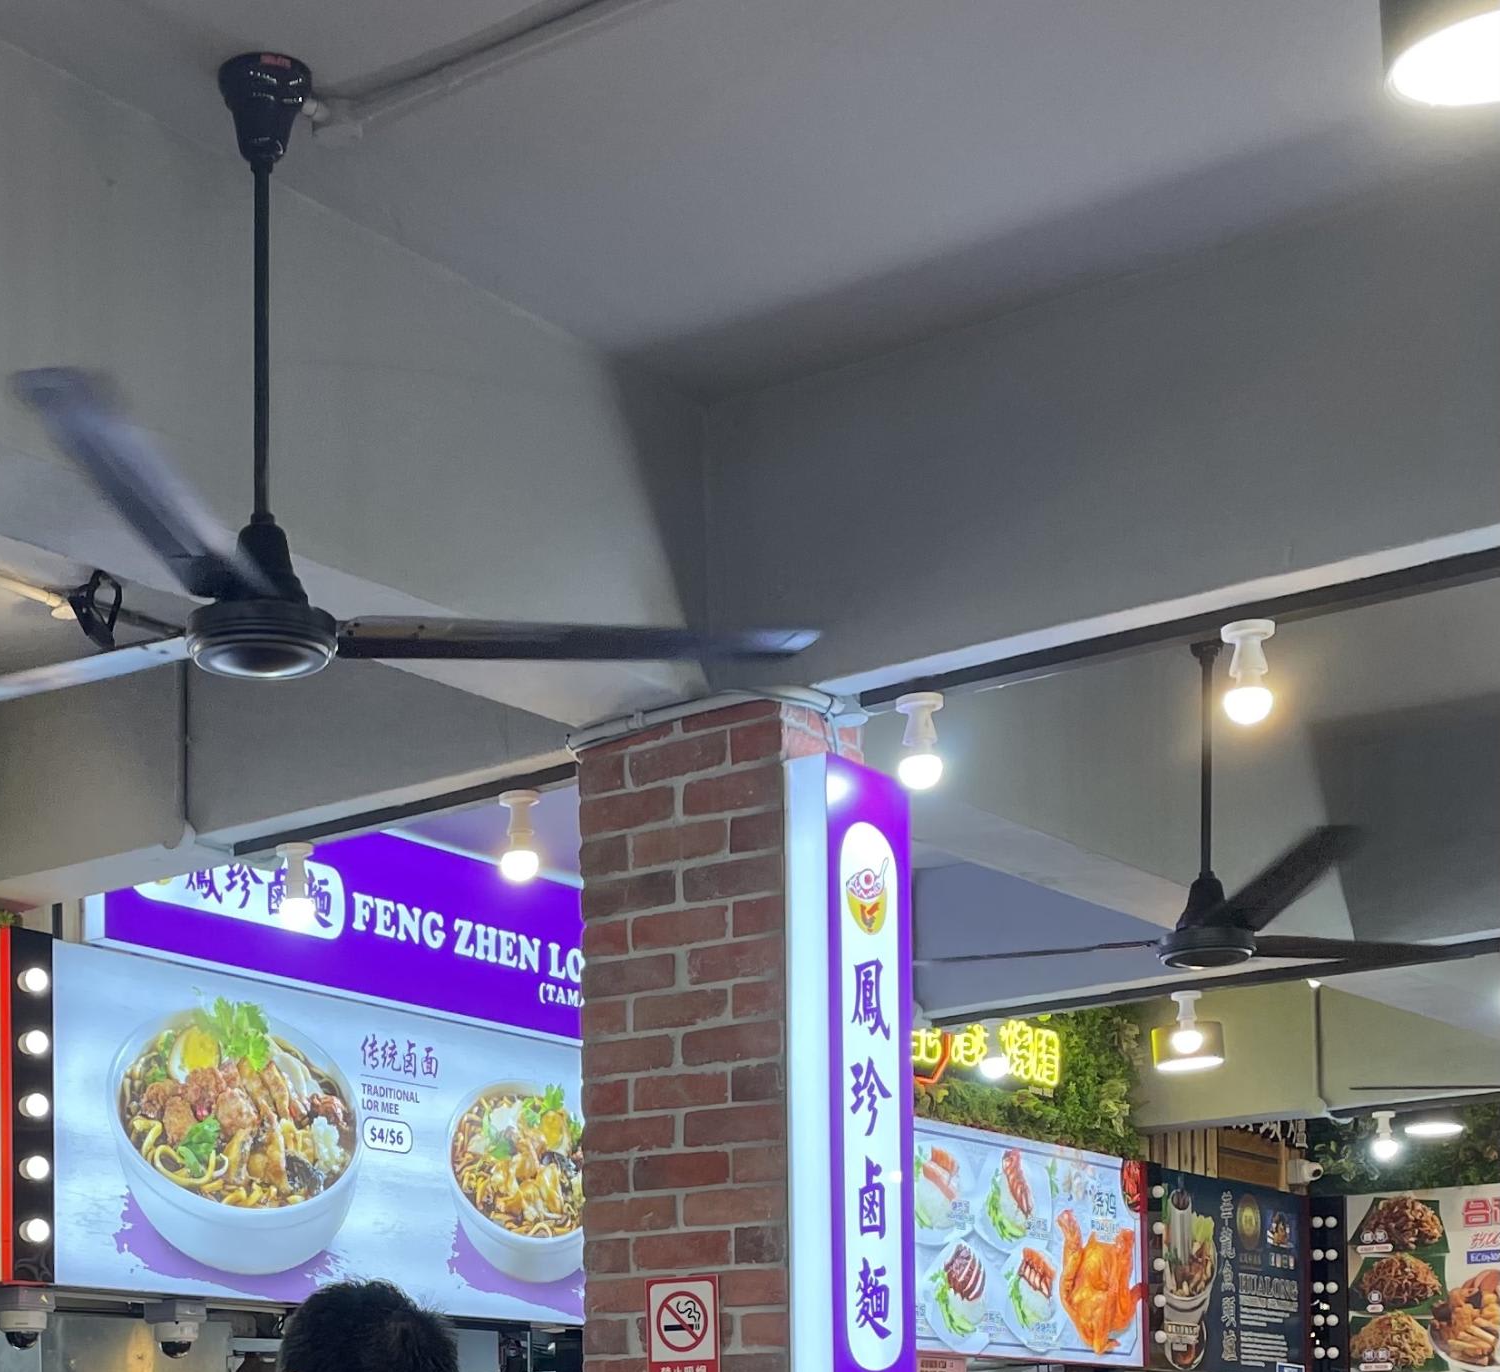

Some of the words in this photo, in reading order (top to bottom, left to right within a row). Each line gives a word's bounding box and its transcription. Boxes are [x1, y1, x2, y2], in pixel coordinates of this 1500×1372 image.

[352, 893, 445, 951] FENG
[454, 919, 541, 972] ZHEN
[539, 982, 583, 1008] (TAM
[360, 1033, 439, 1079] 传统卤面
[361, 1083, 420, 1103] TRADITIONAL
[362, 1099, 379, 1112] LOR
[381, 1102, 399, 1115] MEE
[370, 1126, 403, 1145] $4/$6
